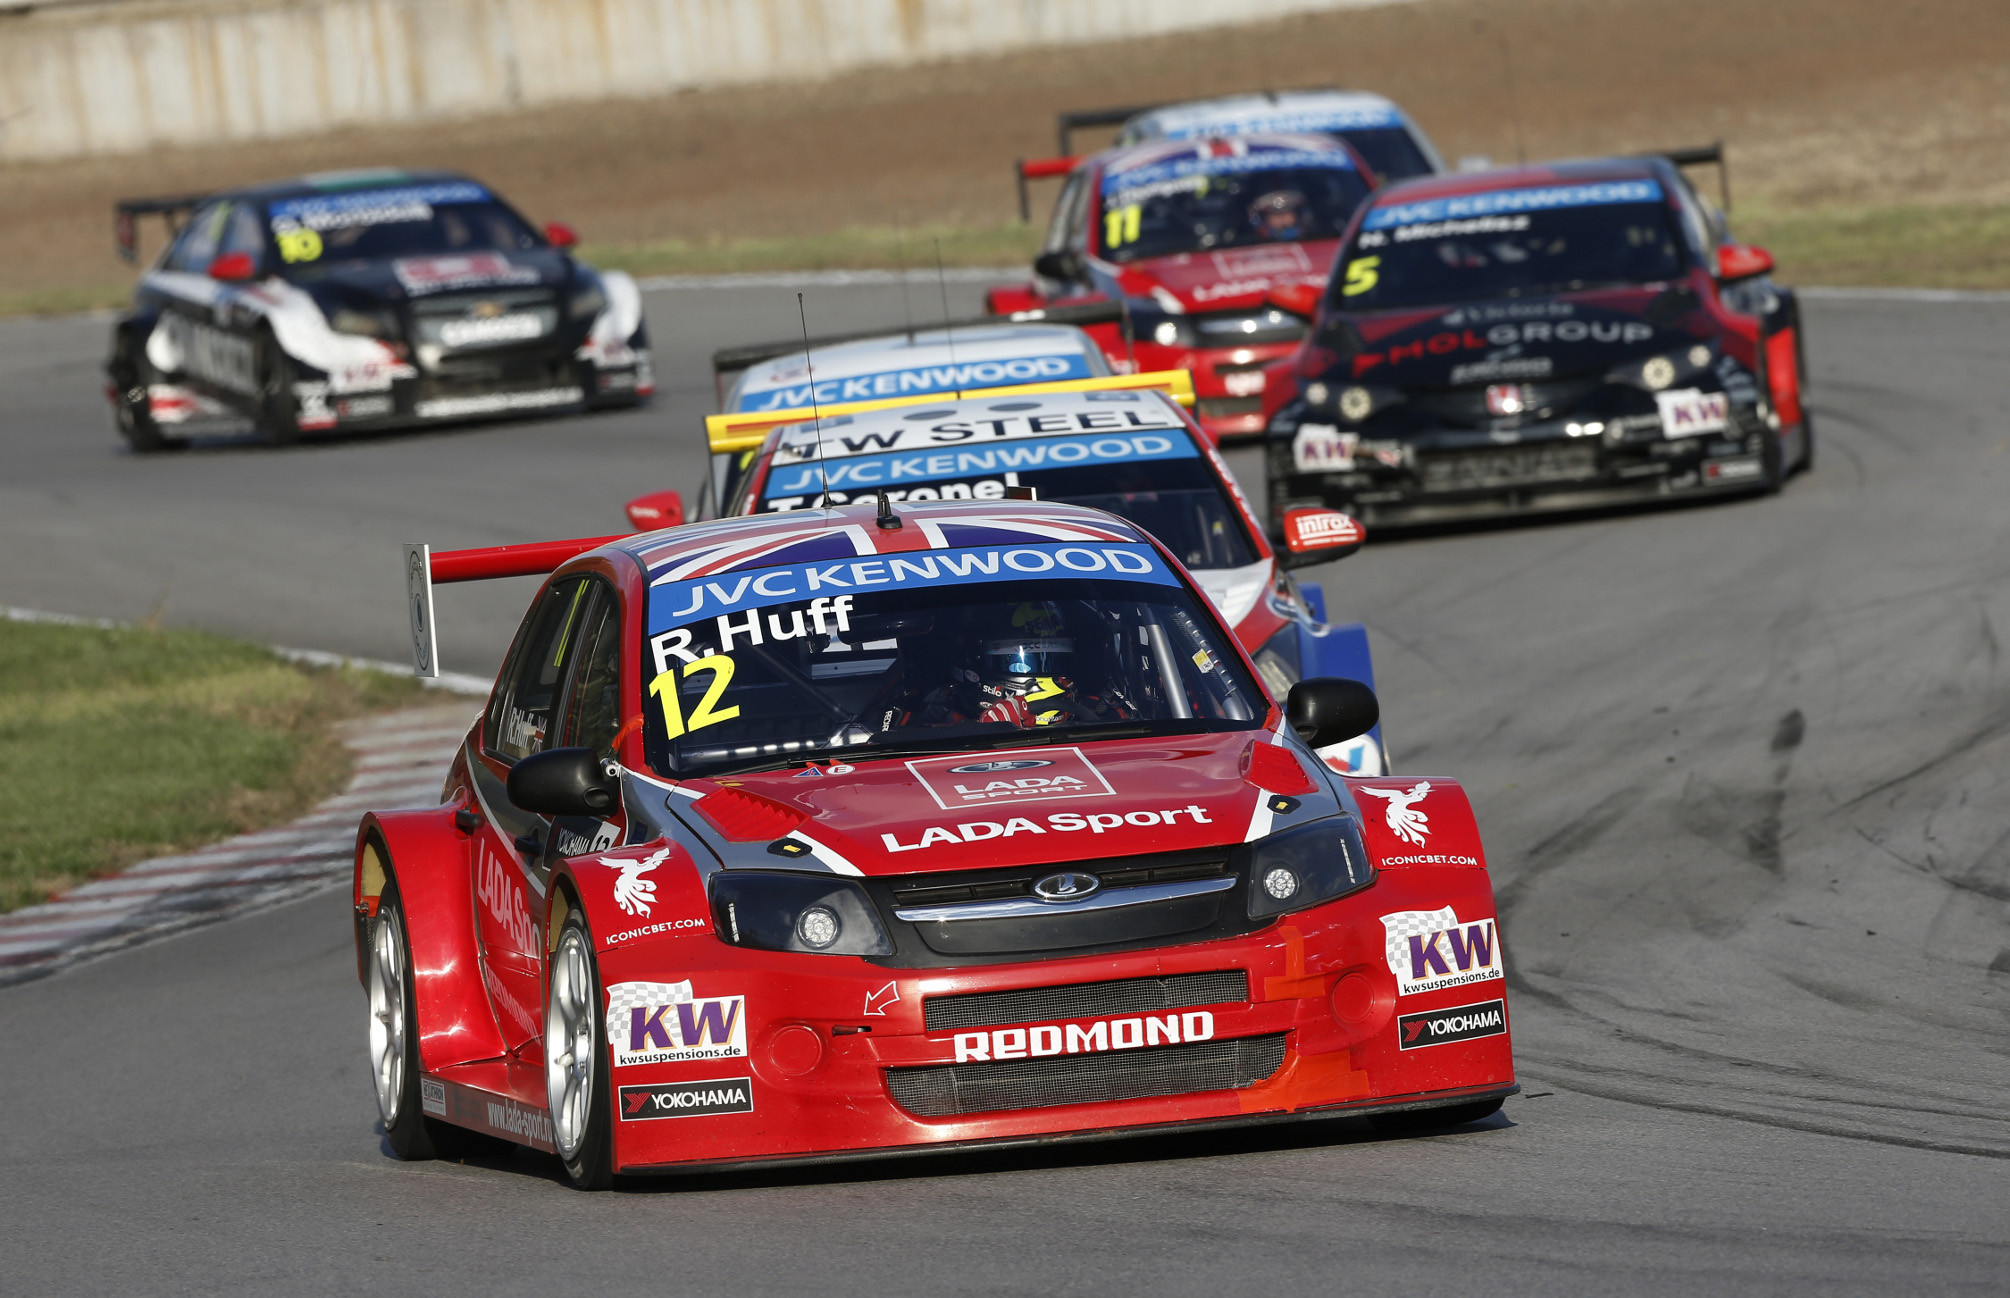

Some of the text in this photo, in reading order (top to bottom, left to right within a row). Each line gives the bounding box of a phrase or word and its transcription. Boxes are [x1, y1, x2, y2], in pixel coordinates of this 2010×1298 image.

[1447, 182, 1649, 216] KENWOOD
[1104, 204, 1142, 249] 11
[1342, 255, 1381, 297] 5
[758, 357, 1071, 410] JVC KENWOOD
[798, 411, 1178, 459] TW STEEL
[783, 435, 1172, 490] JVC KENWOOD
[672, 547, 1154, 617] JVC KENWOOD
[650, 595, 854, 675] R.Huff
[649, 654, 740, 740] 12
[954, 776, 1086, 794] LADA
[962, 784, 1088, 801] SPORT
[880, 805, 1213, 853] LADA Sport
[1381, 855, 1478, 866] ICONICBET.COM
[477, 837, 515, 940] LADA
[606, 918, 706, 945] ICONICBET.COM
[1408, 922, 1495, 981] KW
[1403, 967, 1500, 994] kwsuspensions.de
[630, 1000, 743, 1052] KW
[1427, 1009, 1502, 1036] YOKOHAMA
[619, 1046, 741, 1065] kwsuspensions.de
[651, 1088, 746, 1110] YOKOHAMA
